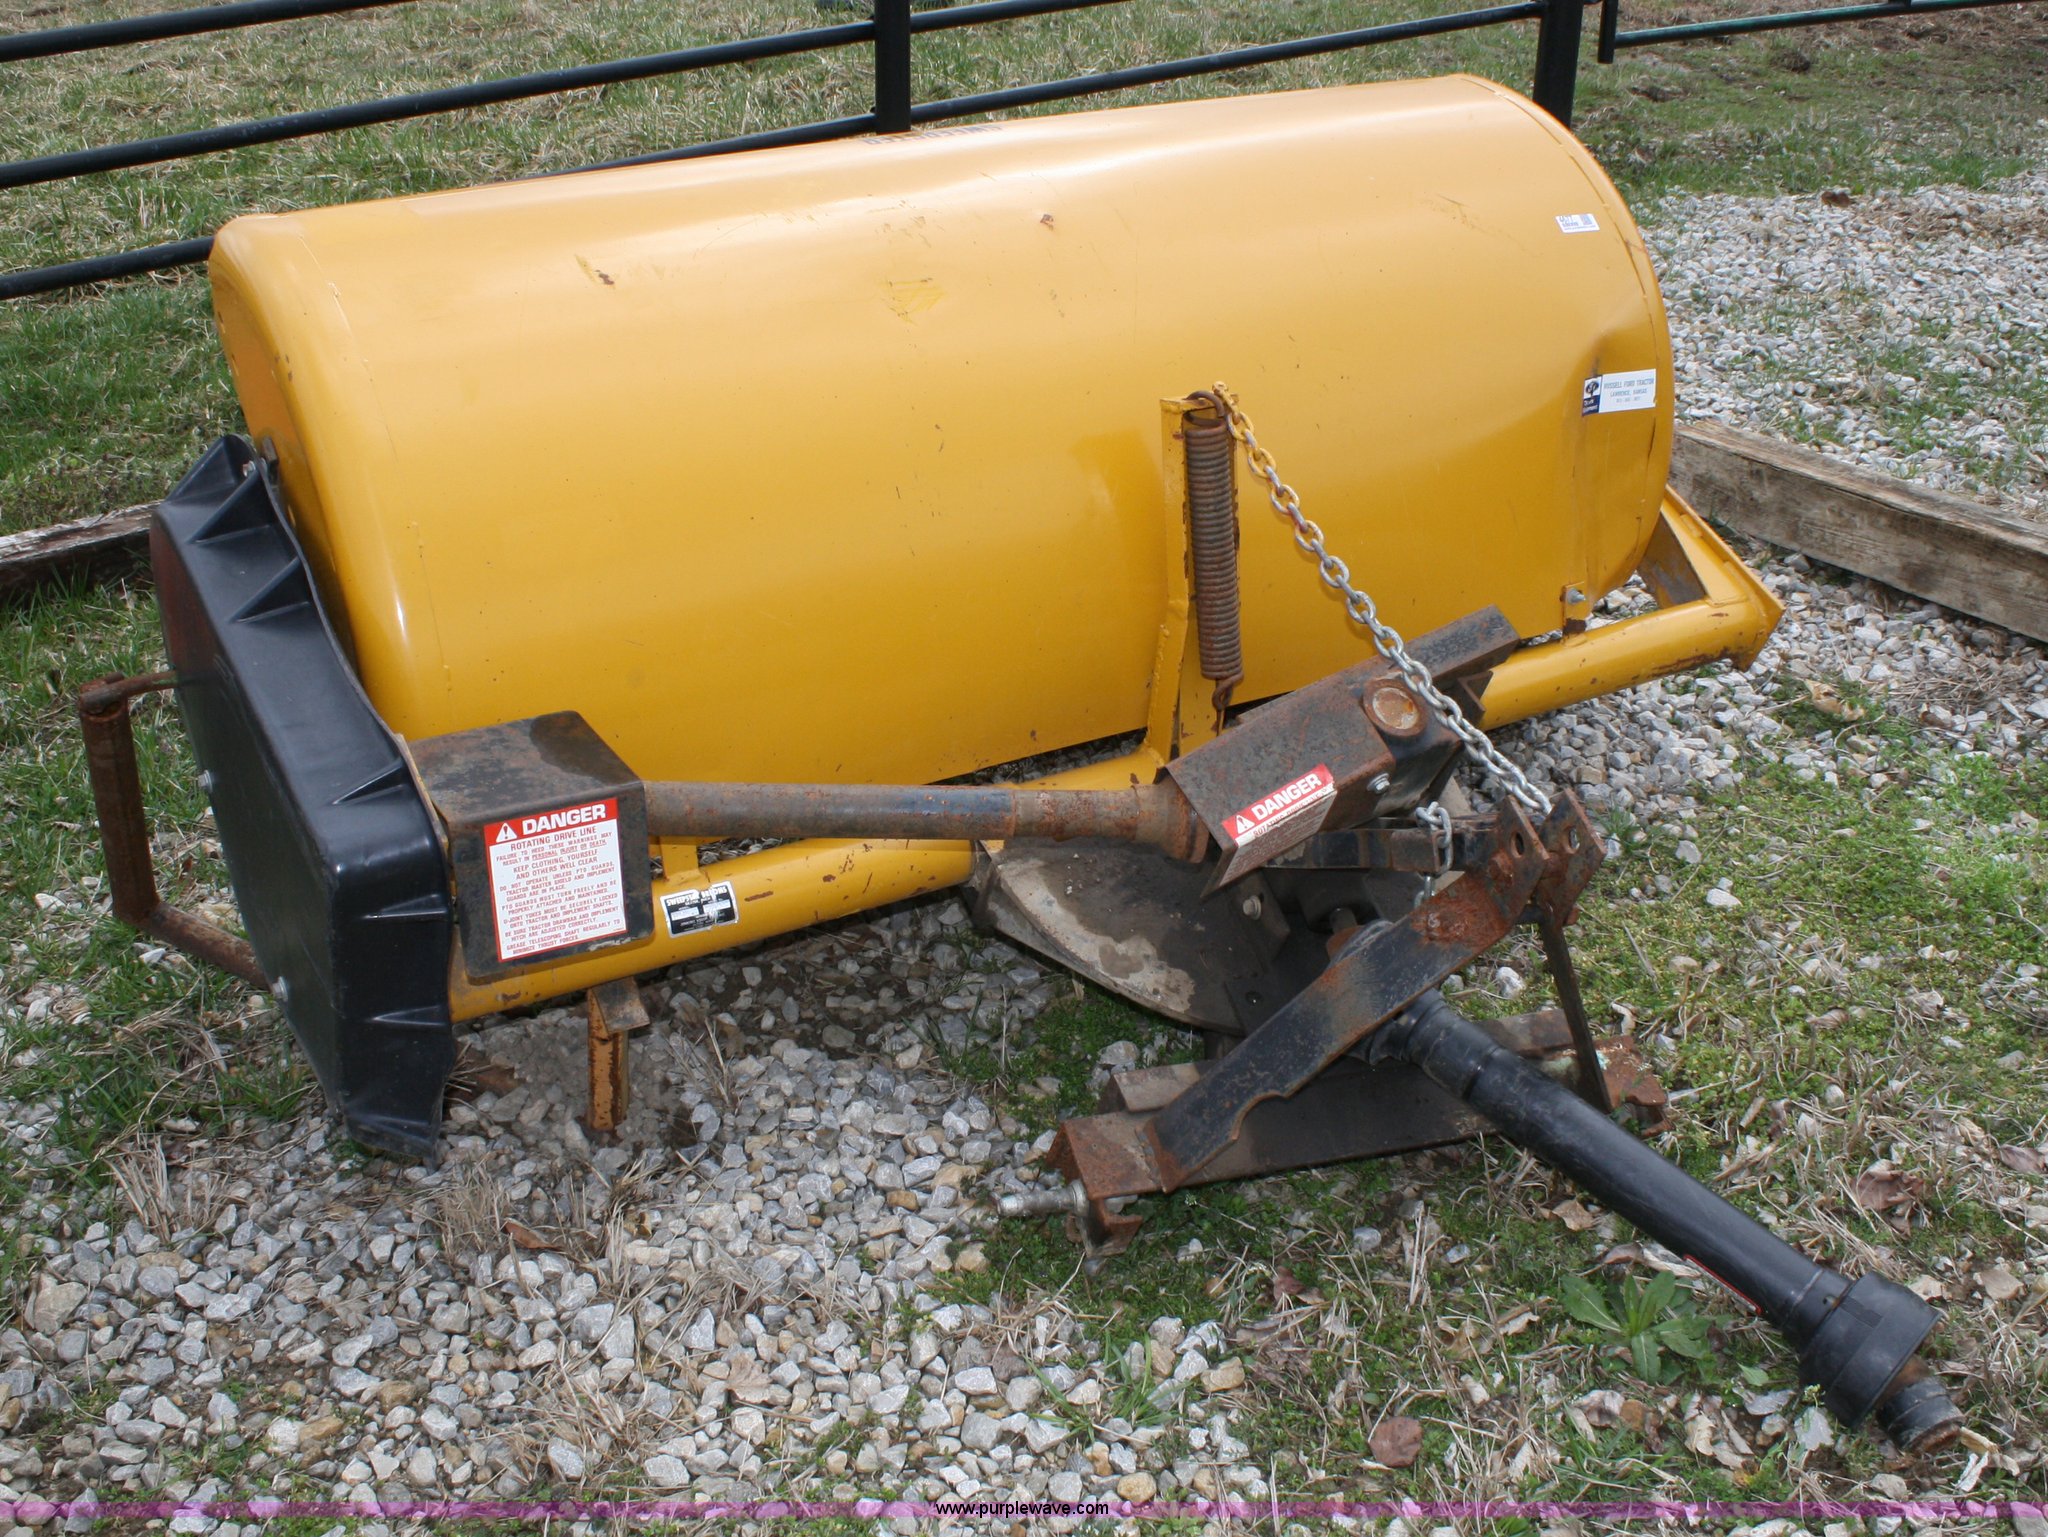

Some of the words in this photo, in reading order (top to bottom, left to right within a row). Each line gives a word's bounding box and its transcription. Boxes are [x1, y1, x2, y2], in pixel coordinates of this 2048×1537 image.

[1251, 773, 1322, 820] DANGER
[522, 804, 606, 835] DANGER
[511, 836, 550, 851] ROTATING
[554, 828, 576, 842] DRIVE
[580, 826, 596, 836] LINE
[496, 853, 517, 861] FAILURE
[532, 845, 544, 854] HEED
[549, 842, 564, 850] THESE
[503, 858, 522, 866] RESULT
[532, 850, 557, 860] PERSONAL
[513, 864, 529, 873] KEEP
[567, 849, 598, 861] YOURSELF
[511, 881, 521, 889] NOT
[526, 876, 548, 885] OPERATE
[553, 871, 572, 879] UNLESS
[516, 871, 530, 880] AND
[533, 865, 557, 877] OTHERS
[560, 861, 576, 870] WELL
[578, 857, 598, 867] CLEAR
[506, 886, 529, 896] TRACTOR
[531, 881, 551, 890] MASTER
[554, 877, 571, 885] SHIELD
[587, 867, 615, 877] IMPLEMENT
[502, 903, 513, 911] PTO
[515, 899, 537, 908] GUARDS
[539, 894, 555, 903] MUST
[574, 885, 594, 895] FREELY
[507, 892, 527, 902] GUARDS
[508, 905, 534, 915] PROPERLY
[536, 899, 562, 909] ATTACHED
[565, 895, 575, 903] AND
[526, 911, 542, 920] YOKES
[544, 907, 557, 915] MUST
[599, 893, 618, 902] LOCKED
[510, 921, 524, 929] ONTO
[526, 915, 548, 925] TRACTOR
[550, 912, 560, 920] AND
[563, 904, 591, 915] IMPLEMENT
[529, 922, 550, 932] TRACTOR
[553, 916, 577, 926] DRAWBAR
[579, 912, 589, 920] AND
[591, 906, 619, 917] IMPLEMENT
[506, 940, 526, 951] GREASE
[529, 933, 562, 945] TELESCOPING
[565, 929, 580, 937] SHAFT
[583, 920, 611, 932] REGULARLY
[511, 933, 527, 942] HITCH
[541, 924, 566, 935] ADJUSTED
[538, 940, 557, 949] THRUST
